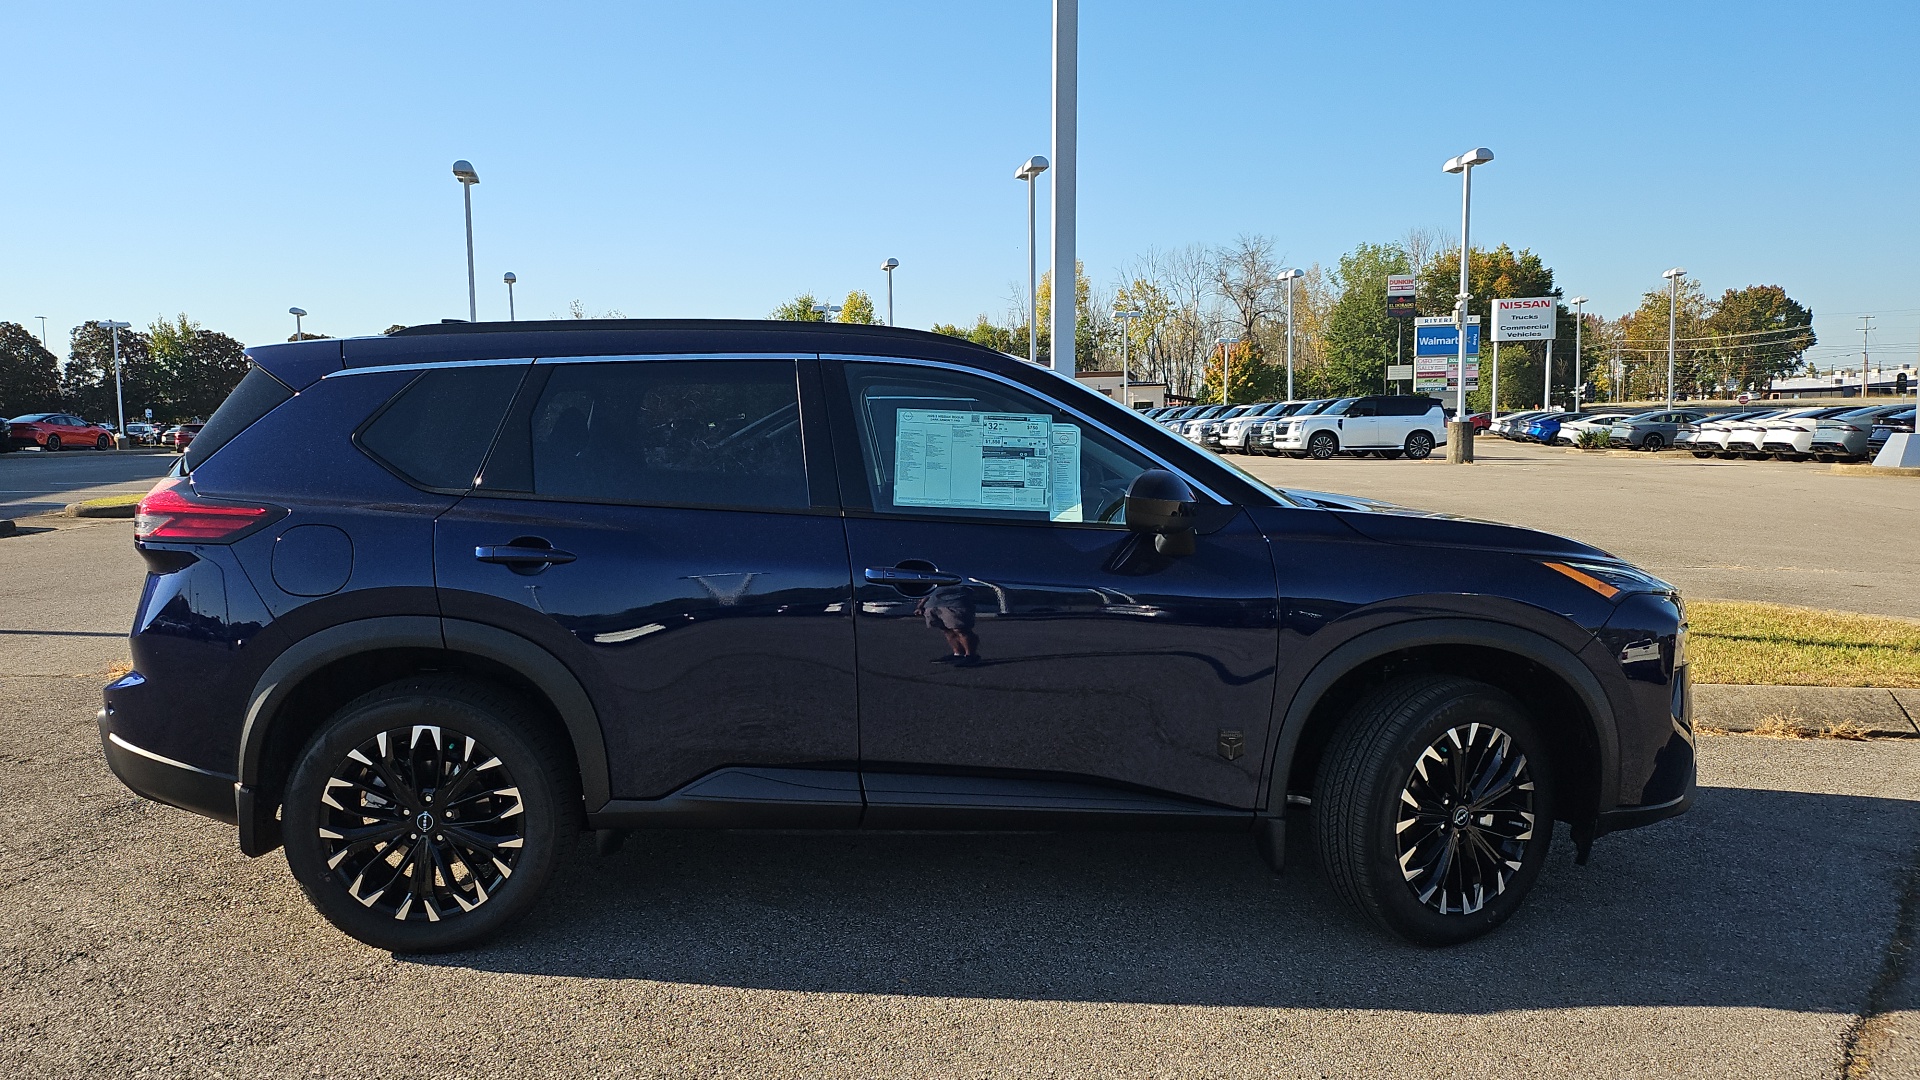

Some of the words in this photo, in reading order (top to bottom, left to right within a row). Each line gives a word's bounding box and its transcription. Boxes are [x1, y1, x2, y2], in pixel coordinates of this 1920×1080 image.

[1500, 300, 1551, 309] NISSAN
[1418, 336, 1459, 346] Walmart
[988, 422, 998, 430] 32
